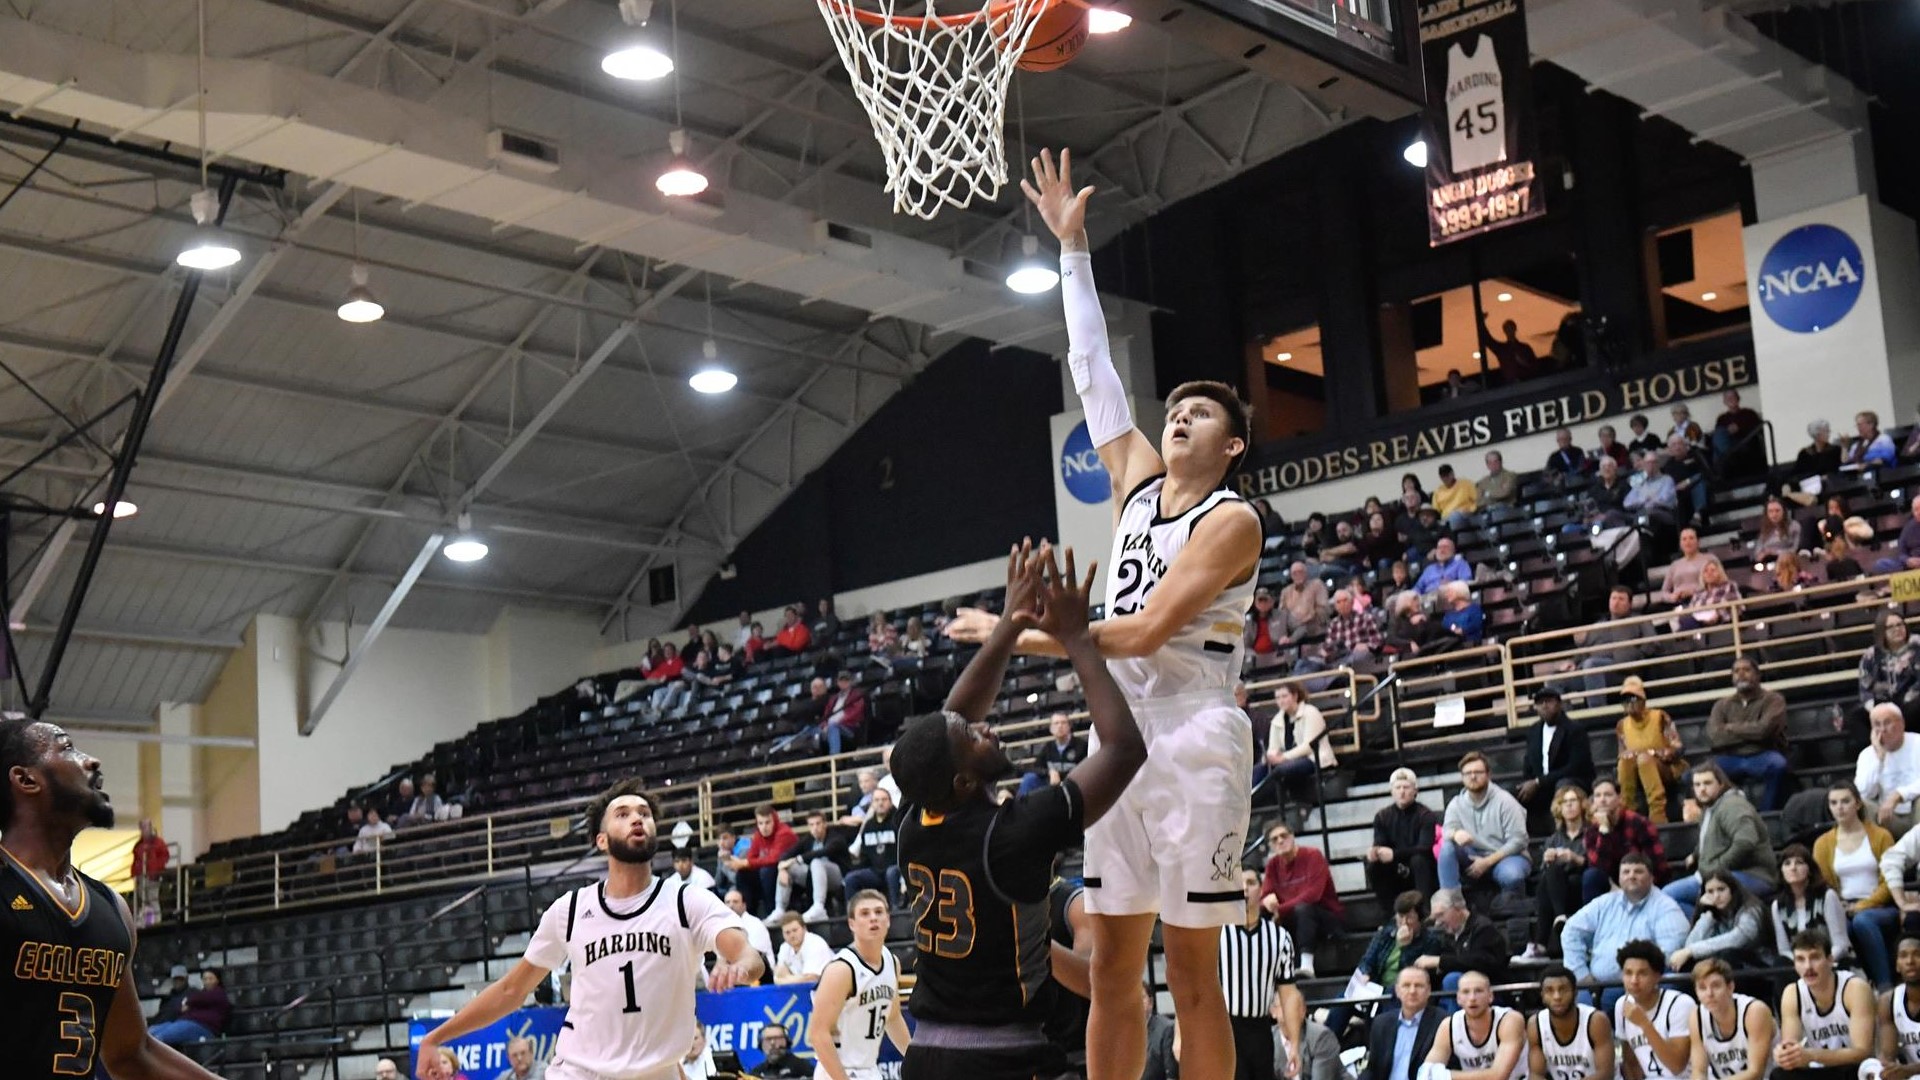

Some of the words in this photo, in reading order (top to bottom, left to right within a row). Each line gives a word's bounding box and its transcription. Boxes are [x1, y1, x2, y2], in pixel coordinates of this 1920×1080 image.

[1455, 100, 1497, 139] 45
[1440, 187, 1530, 236] 1993-1997
[1763, 256, 1859, 301] NCAA
[1238, 415, 1492, 497] RHODES-REAVES
[1503, 390, 1607, 438] FIELD
[1620, 355, 1750, 411] HOUSE
[1064, 449, 1101, 477] NC
[1114, 558, 1155, 616] 2
[1893, 577, 1920, 598] HOM
[908, 862, 976, 959] 23
[585, 932, 671, 967] HARDING
[618, 960, 641, 1014] 1
[53, 992, 96, 1076] 3
[740, 1021, 763, 1050] IT
[865, 1004, 888, 1040] 15
[486, 1042, 506, 1069] IT
[1647, 1051, 1662, 1077] 4
